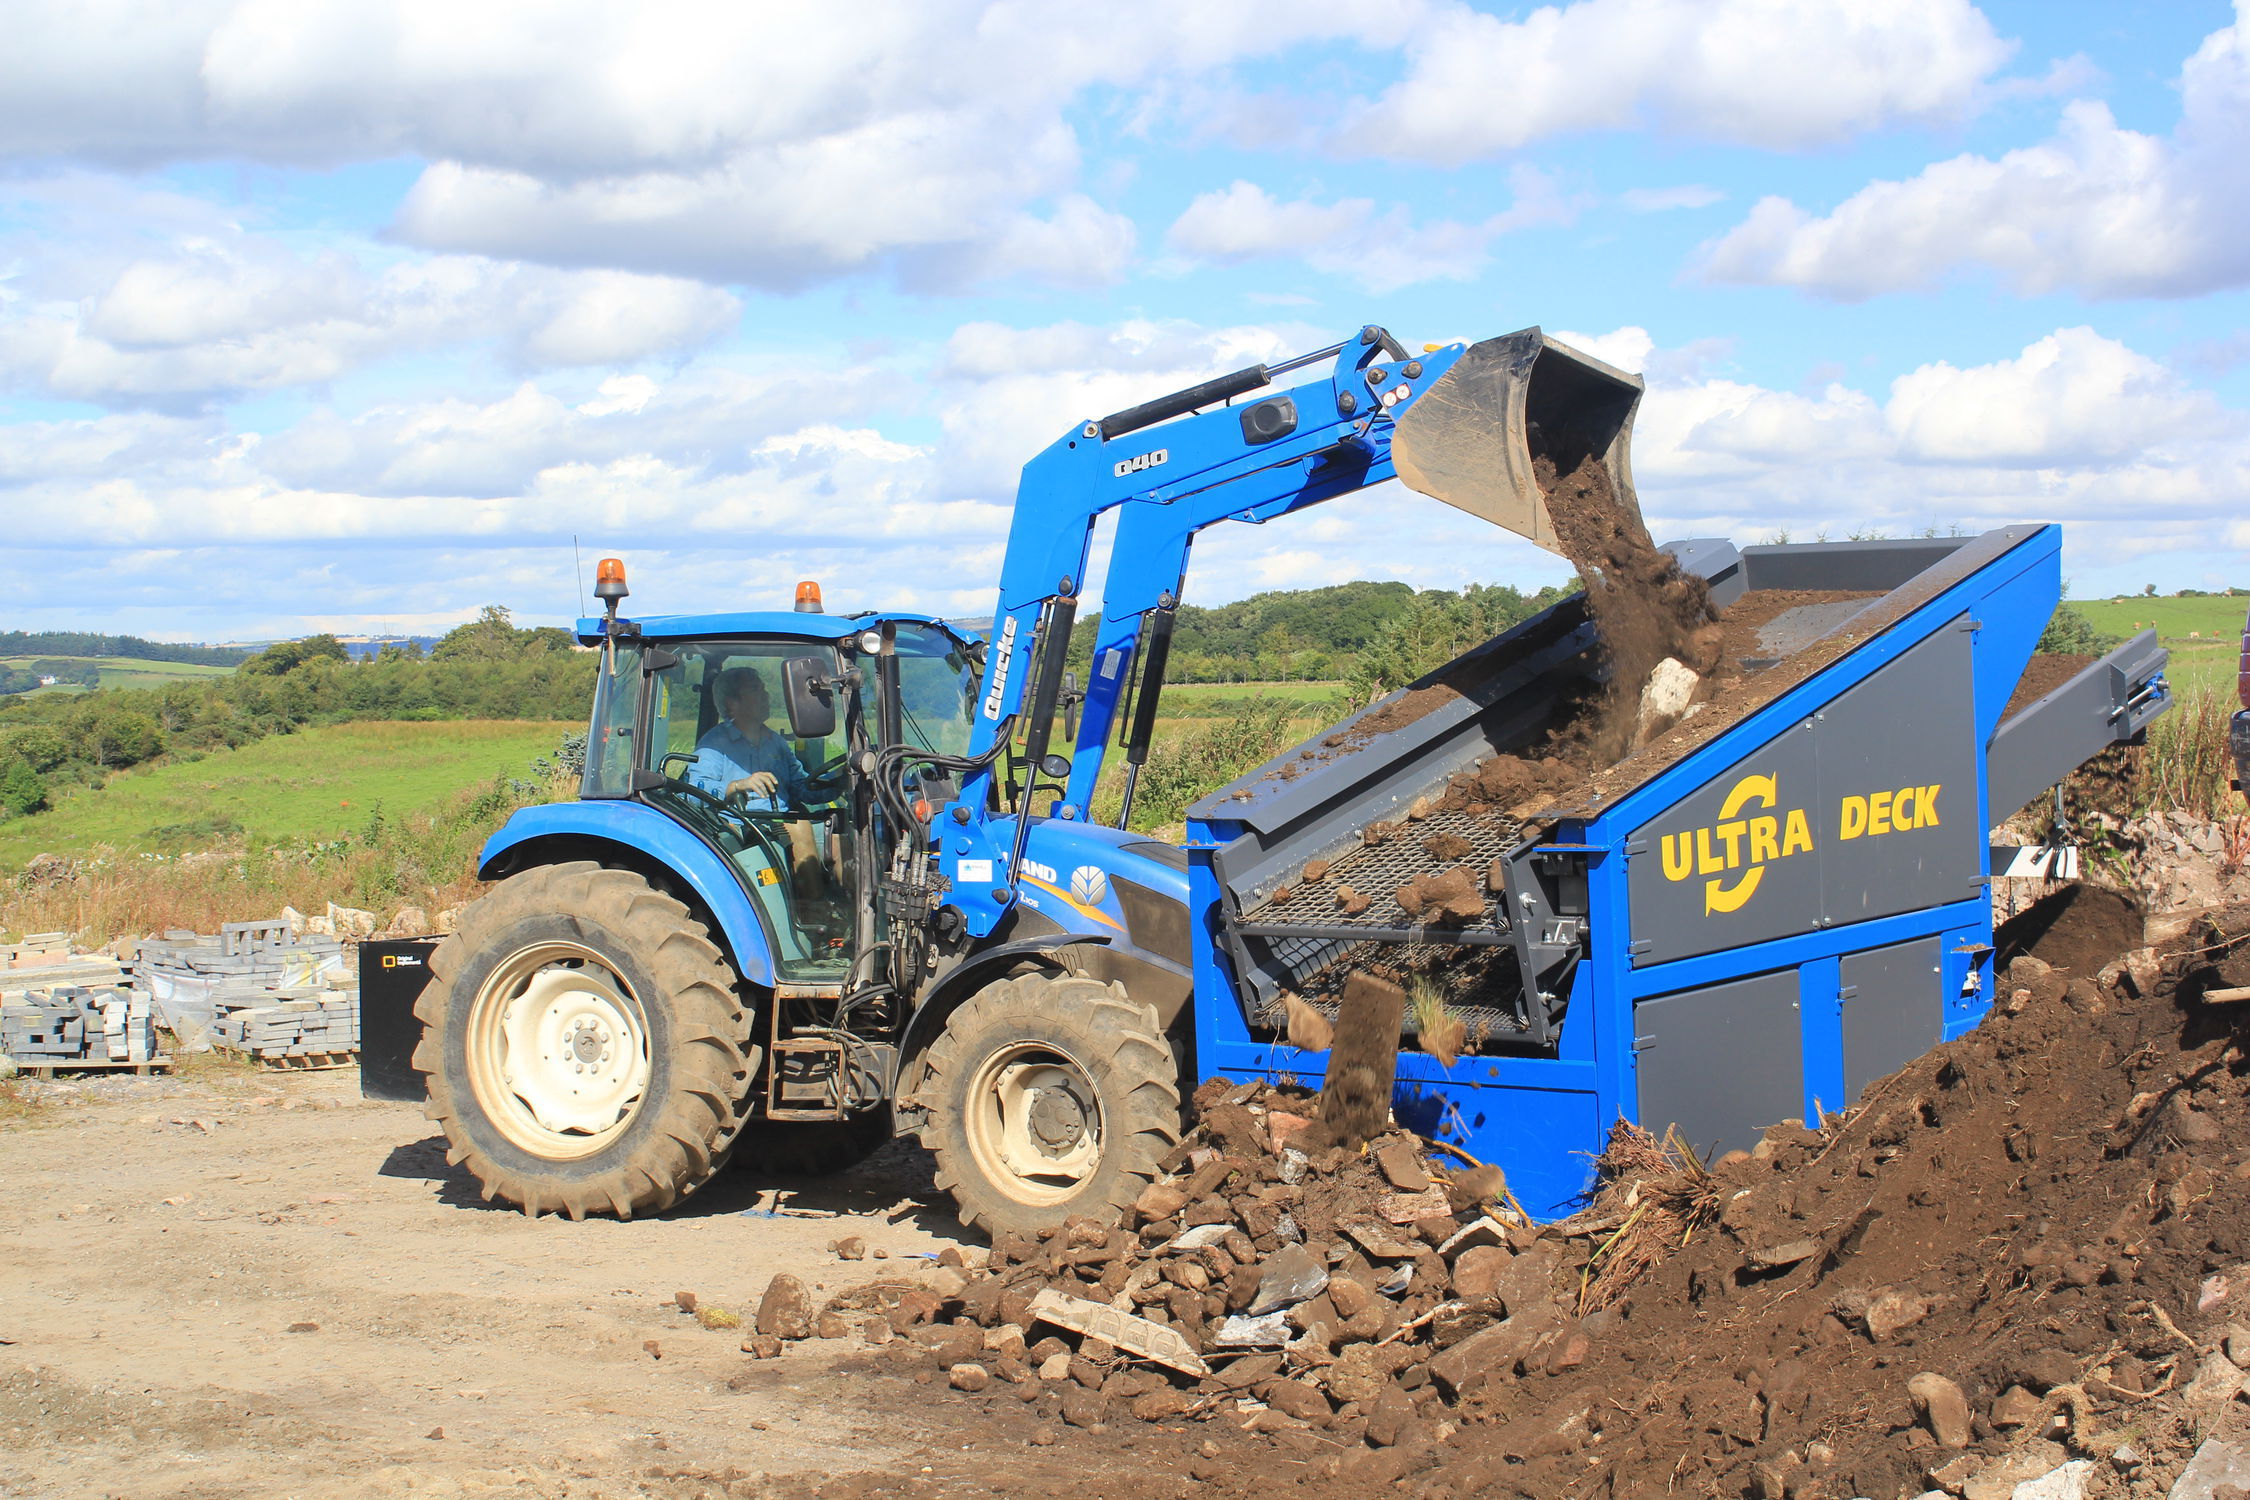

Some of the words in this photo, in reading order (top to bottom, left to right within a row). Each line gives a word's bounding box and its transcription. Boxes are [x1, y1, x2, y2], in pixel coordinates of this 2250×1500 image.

[1114, 448, 1168, 478] Q40
[1661, 809, 1814, 882] ULTRA
[1840, 784, 1941, 840] DECK
